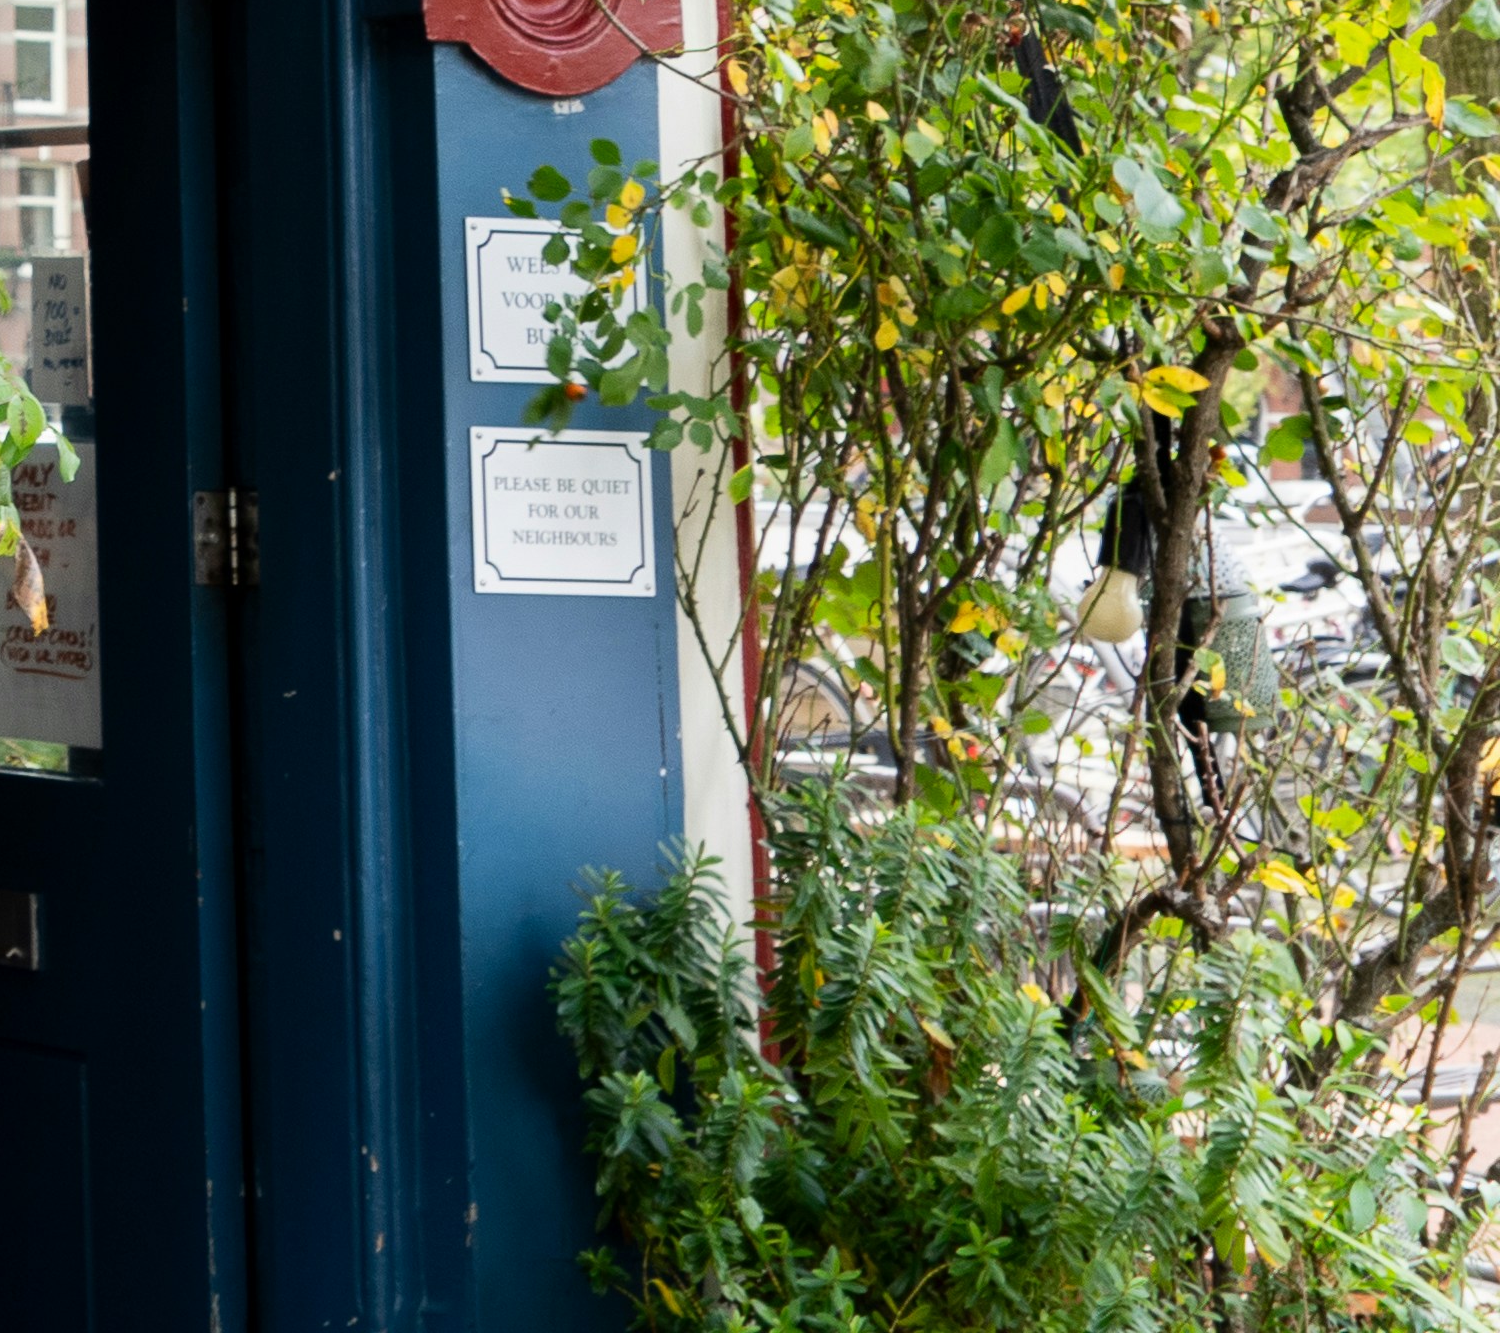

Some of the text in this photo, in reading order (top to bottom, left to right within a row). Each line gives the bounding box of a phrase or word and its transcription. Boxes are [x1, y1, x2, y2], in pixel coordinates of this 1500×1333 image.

[493, 476, 632, 496] PLEASE BE QUIET
[528, 503, 600, 520] FOR OUR
[512, 529, 618, 547] NEIGHBOURS
